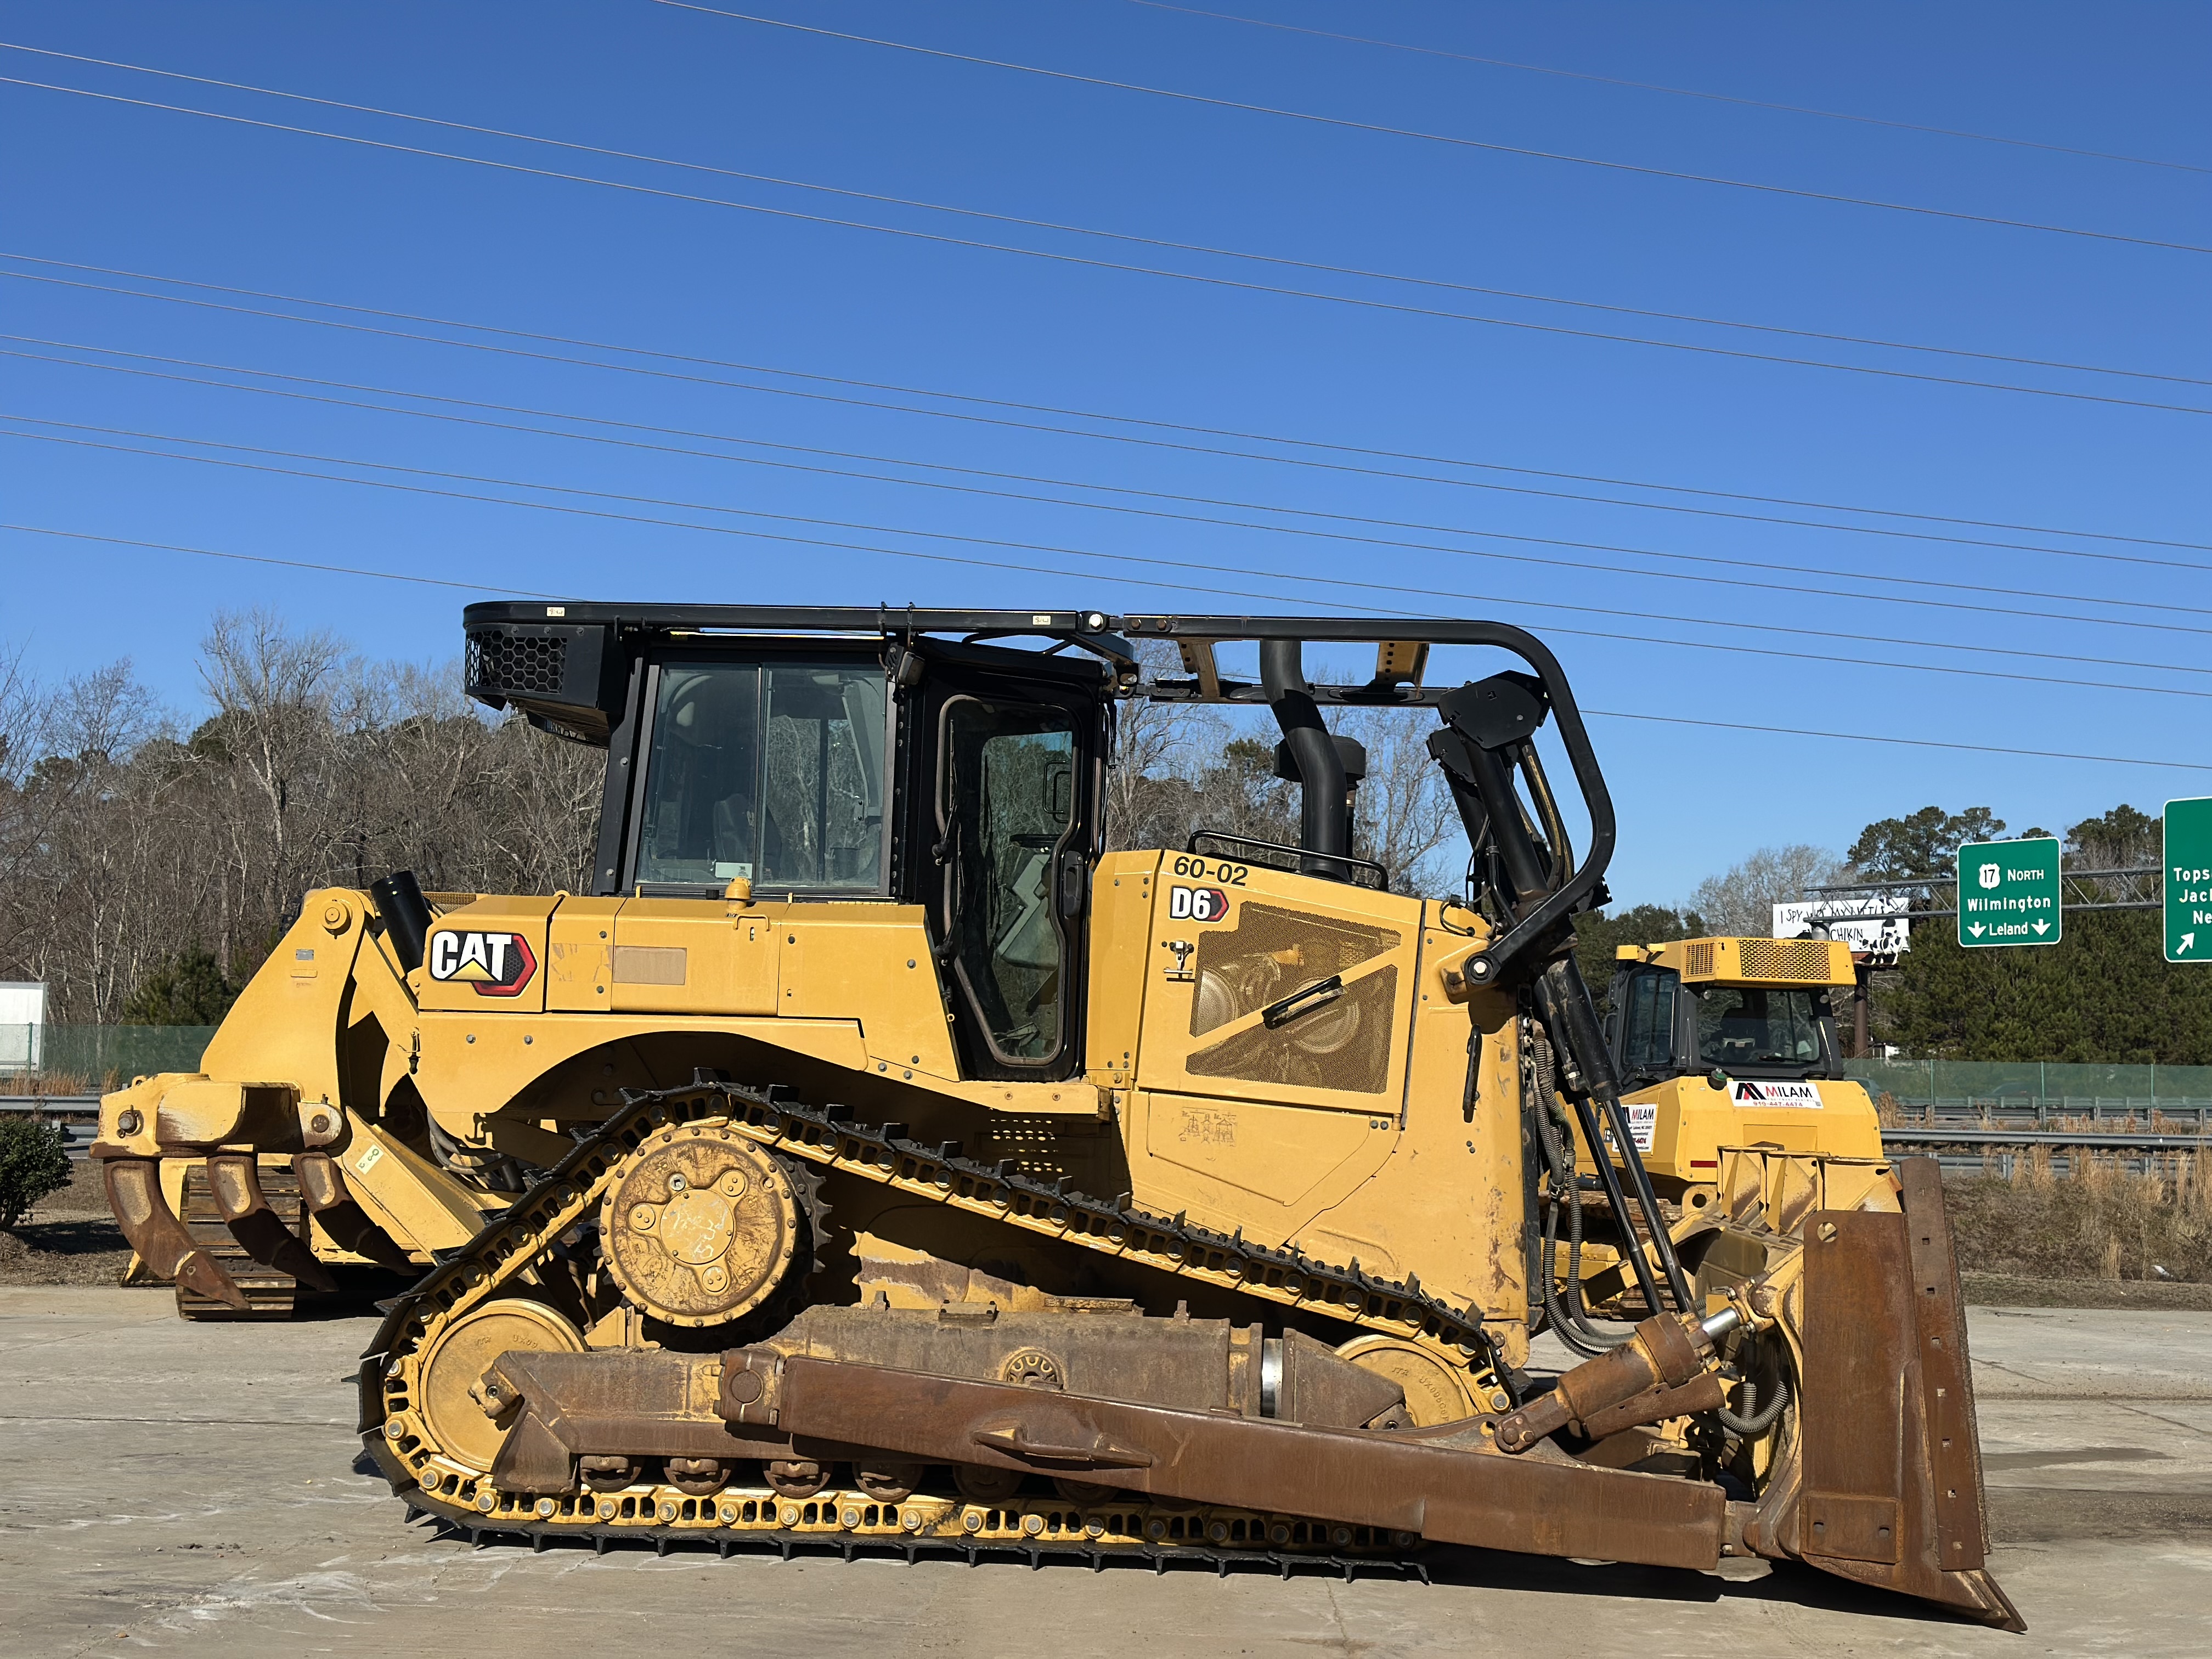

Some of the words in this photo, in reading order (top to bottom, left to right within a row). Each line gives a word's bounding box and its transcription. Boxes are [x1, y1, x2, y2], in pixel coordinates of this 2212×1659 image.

[1174, 856, 1249, 887] 60-02
[1984, 869, 1995, 883] 17
[2007, 869, 2045, 882] NORTH
[2173, 867, 2212, 884] Tops
[1171, 887, 1211, 919] D6
[1967, 895, 2051, 913] Wilmington
[1781, 911, 1783, 924] I
[1786, 909, 1803, 923] SPY
[1830, 927, 1863, 941] CHIKIN
[1989, 921, 2028, 936] Leland
[432, 931, 512, 981] CAT
[1765, 1086, 1813, 1098] MILAM
[1632, 1108, 1654, 1120] MILAM
